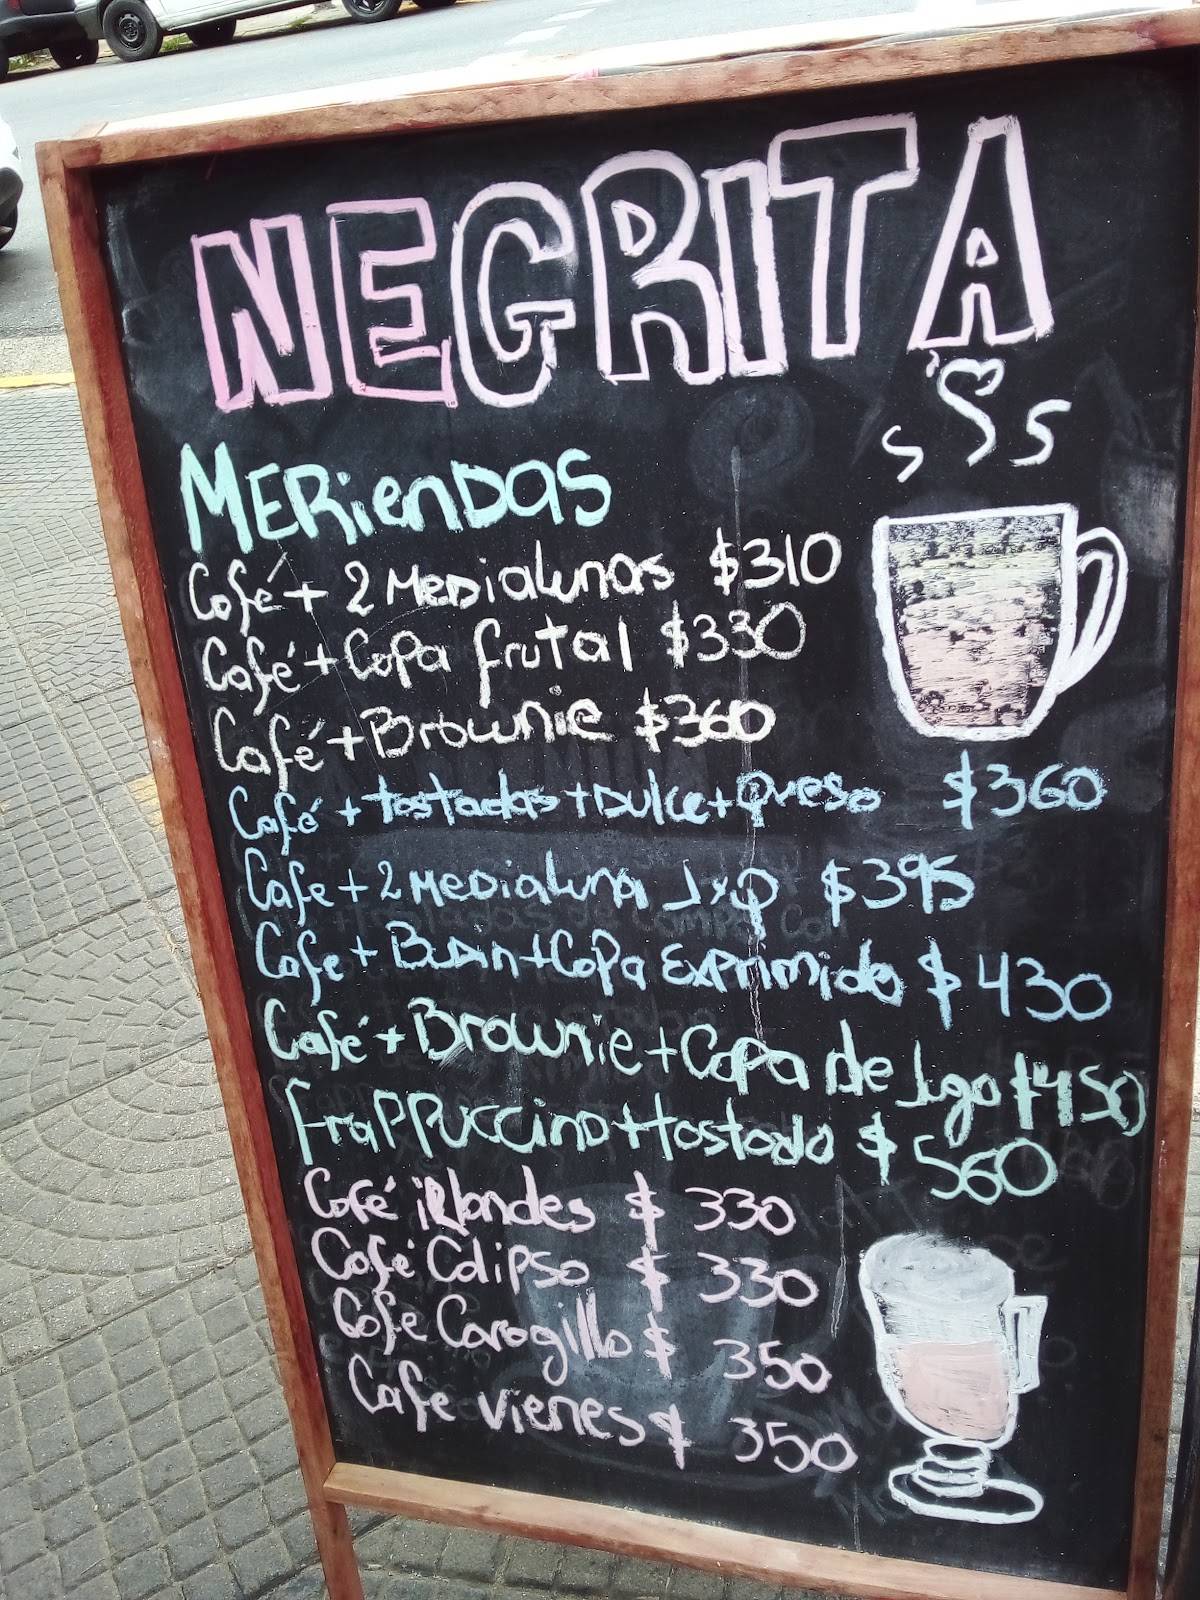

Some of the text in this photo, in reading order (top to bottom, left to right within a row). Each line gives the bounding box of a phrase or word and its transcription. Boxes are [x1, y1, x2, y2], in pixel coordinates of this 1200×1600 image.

[189, 110, 1056, 412] NEGRITA
[343, 560, 374, 617] 2
[708, 528, 844, 596] $310
[201, 634, 302, 716] Café
[660, 600, 807, 670] $330
[213, 706, 325, 793] Café
[633, 686, 778, 754] $360
[229, 784, 325, 856] Café
[942, 748, 1108, 830] $360
[244, 846, 336, 928] Cafe
[377, 859, 403, 902] 2
[821, 852, 976, 929] $395
[254, 920, 347, 1008] Cafe
[263, 996, 370, 1073] Café
[824, 1017, 894, 1096] de
[303, 1166, 400, 1224] Café
[346, 1352, 456, 1434] Cafe
